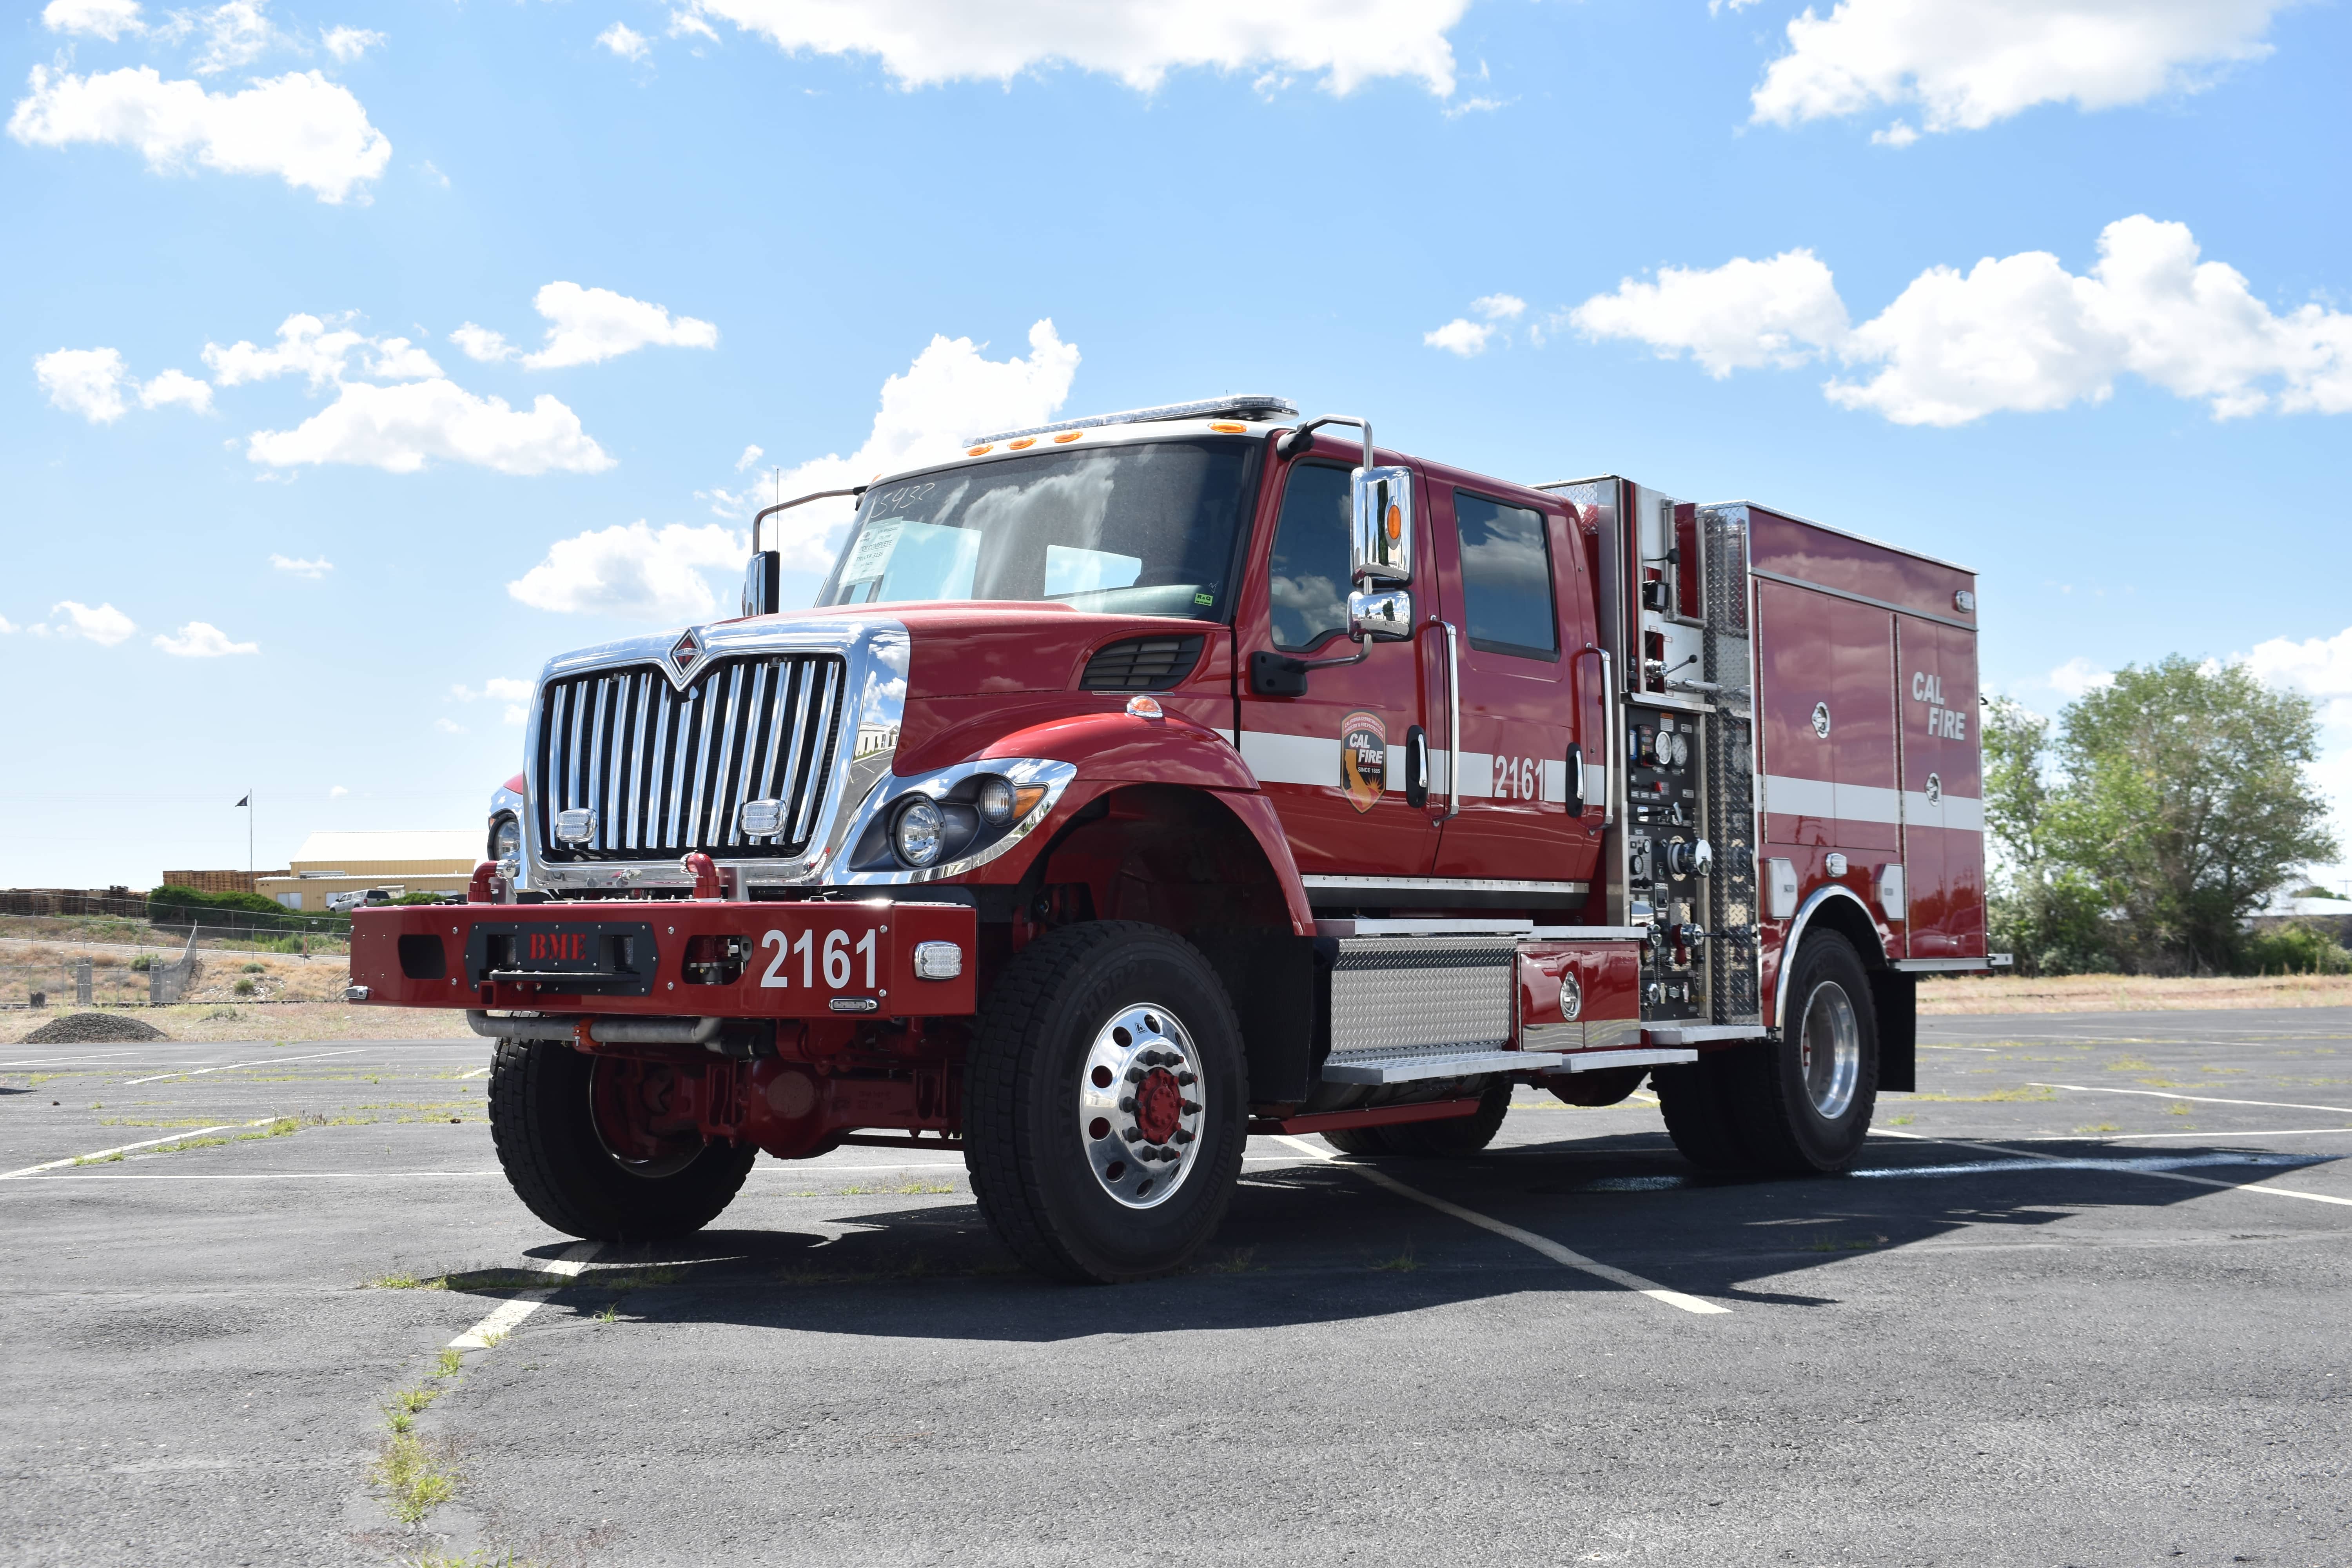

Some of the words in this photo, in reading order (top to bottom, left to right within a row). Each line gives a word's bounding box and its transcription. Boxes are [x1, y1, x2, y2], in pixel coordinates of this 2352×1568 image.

[1912, 671, 1945, 705] CAL
[1344, 723, 1358, 735] FORESTRY
[1367, 723, 1383, 739] PROTECTION
[1345, 717, 1361, 728] CALIFORNIA
[1361, 716, 1379, 728] DEPARTMENT
[1928, 707, 1966, 740] FIRE
[1350, 733, 1370, 748] CAL
[1358, 749, 1383, 764] FIRE
[1494, 755, 1544, 800] 2161
[529, 933, 587, 960] BME
[760, 929, 877, 988] 2161
